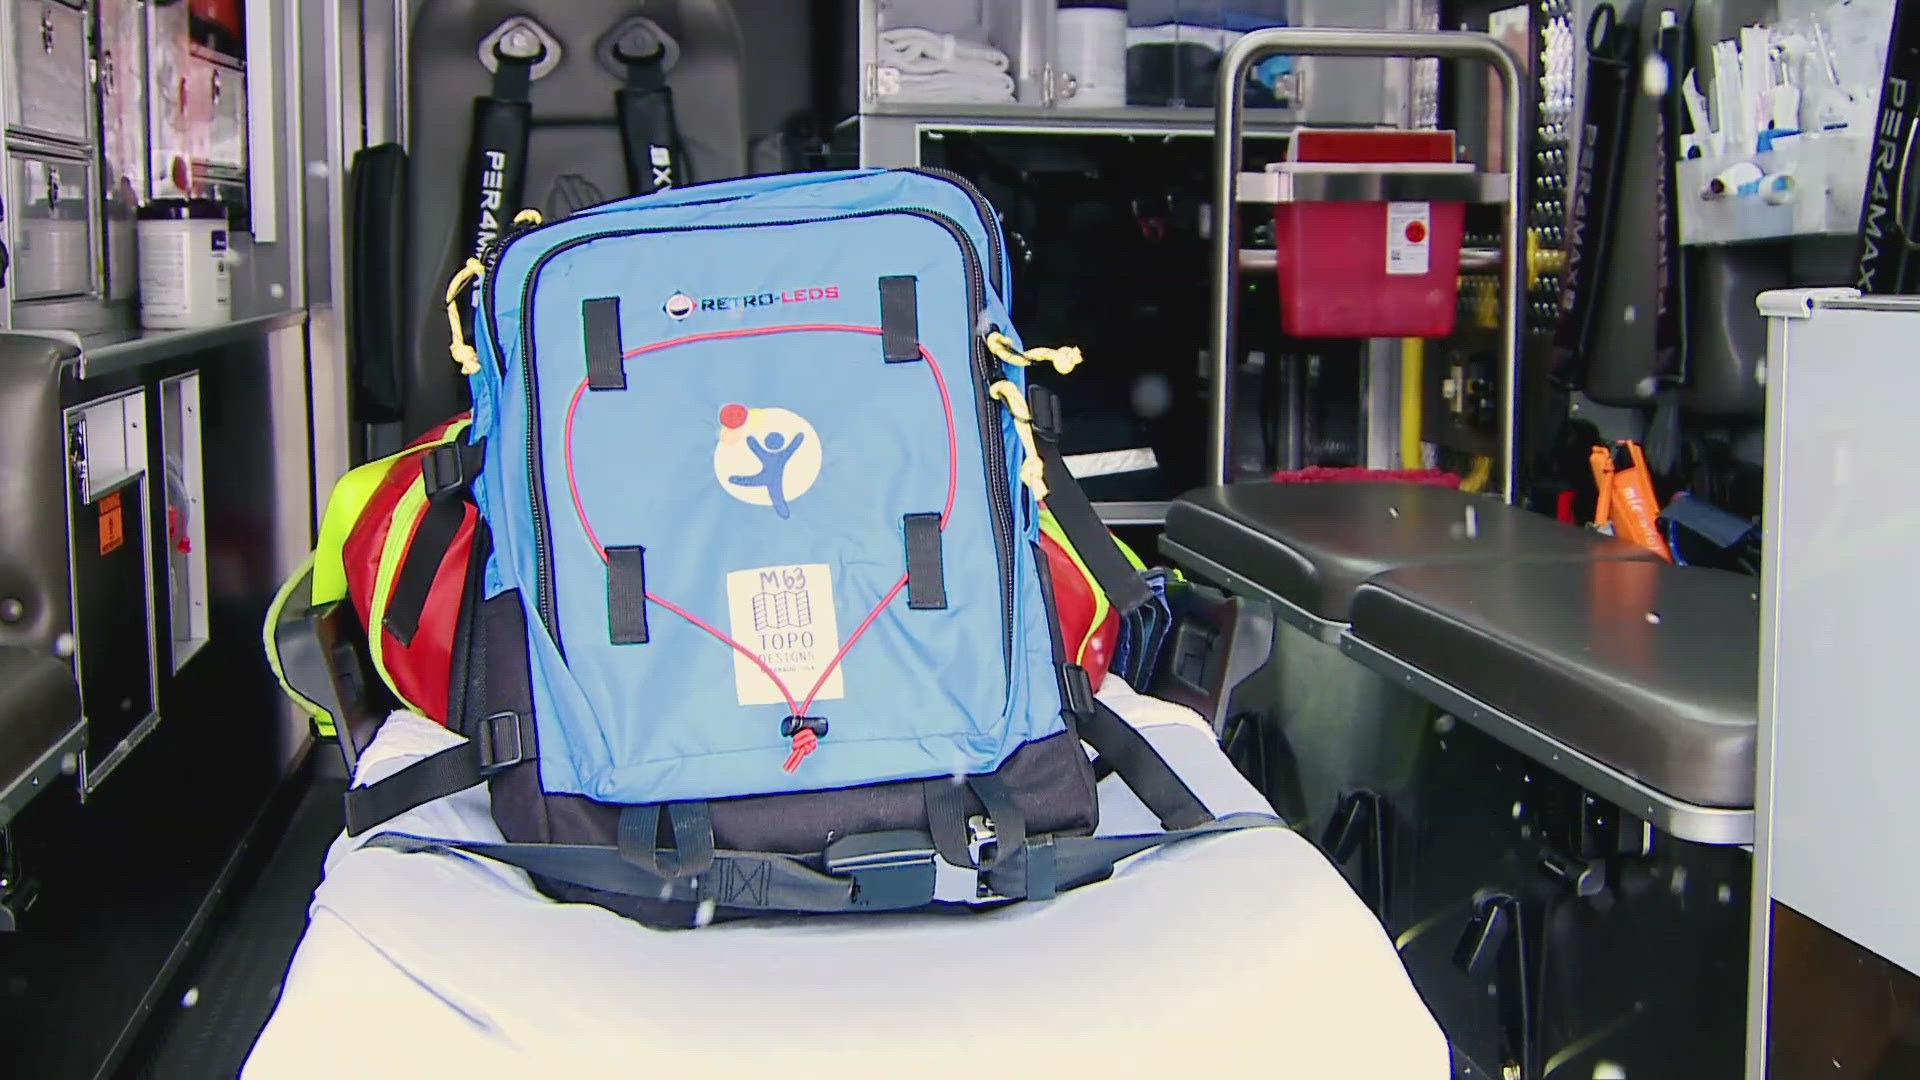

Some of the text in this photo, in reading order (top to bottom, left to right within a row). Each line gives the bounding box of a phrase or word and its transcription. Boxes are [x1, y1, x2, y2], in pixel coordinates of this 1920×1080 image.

[1857, 77, 1907, 292] PER4MAX
[701, 286, 839, 311] RETRO-LEDS
[758, 631, 814, 650] TOPO
[758, 651, 815, 664] DESIGNS
